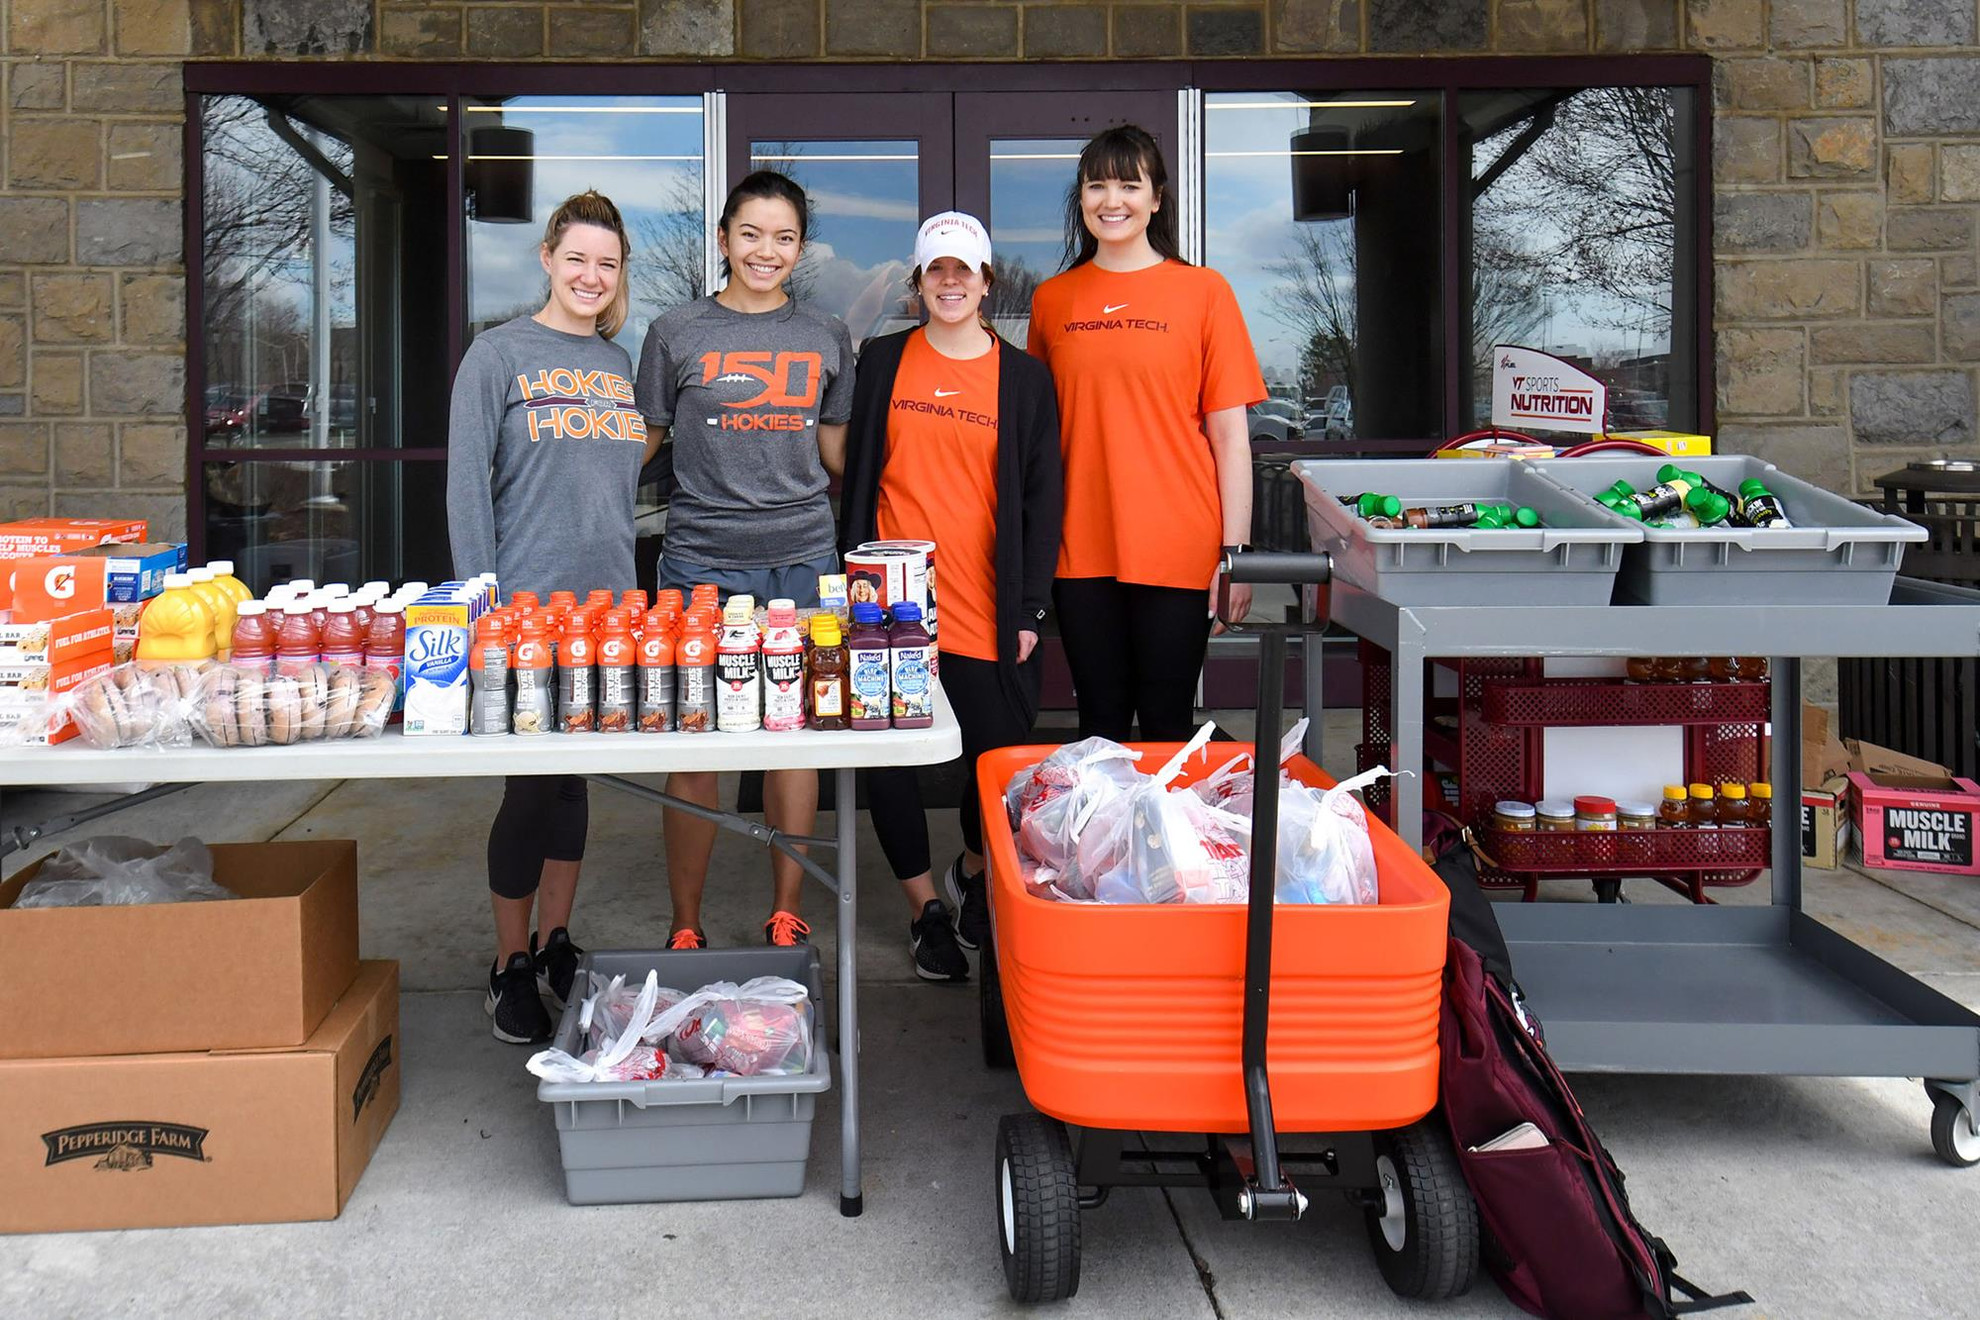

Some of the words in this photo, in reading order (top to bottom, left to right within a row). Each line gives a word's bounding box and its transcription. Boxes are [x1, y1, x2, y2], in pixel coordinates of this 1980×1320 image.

[925, 219, 959, 236] VIRGINIA
[961, 220, 978, 238] TECH
[1064, 319, 1123, 333] VIRGINIA
[1125, 319, 1168, 333] TECH
[699, 351, 822, 409] 150
[1512, 376, 1525, 391] VT
[1525, 376, 1560, 392] SPORTS
[1510, 393, 1593, 415] NUTRITION
[720, 412, 806, 431] HOKIES
[892, 399, 955, 419] VIRGINIA
[957, 409, 998, 430] TECH
[527, 407, 648, 444] HOKIE
[33, 535, 49, 545] TO
[15, 544, 61, 554] MUSCLES
[44, 565, 77, 599] G
[414, 614, 461, 625] PROTEIN
[55, 636, 70, 649] FUEL
[70, 633, 83, 644] FOR
[409, 629, 461, 662] Silk
[570, 640, 587, 657] G
[602, 640, 620, 657] G
[644, 640, 660, 657] G
[684, 640, 701, 657] G
[518, 642, 535, 661] G
[860, 653, 881, 662] Naked
[901, 651, 922, 660] Naked
[426, 656, 453, 668] VANILLA
[719, 654, 756, 668] MUSCLE
[767, 654, 800, 668] MUSCLE
[724, 666, 751, 679] MILK
[772, 667, 796, 680] MILK
[687, 667, 696, 702] SHAKE
[1888, 808, 1966, 833] MUSCLE
[1903, 829, 1951, 851] MILK
